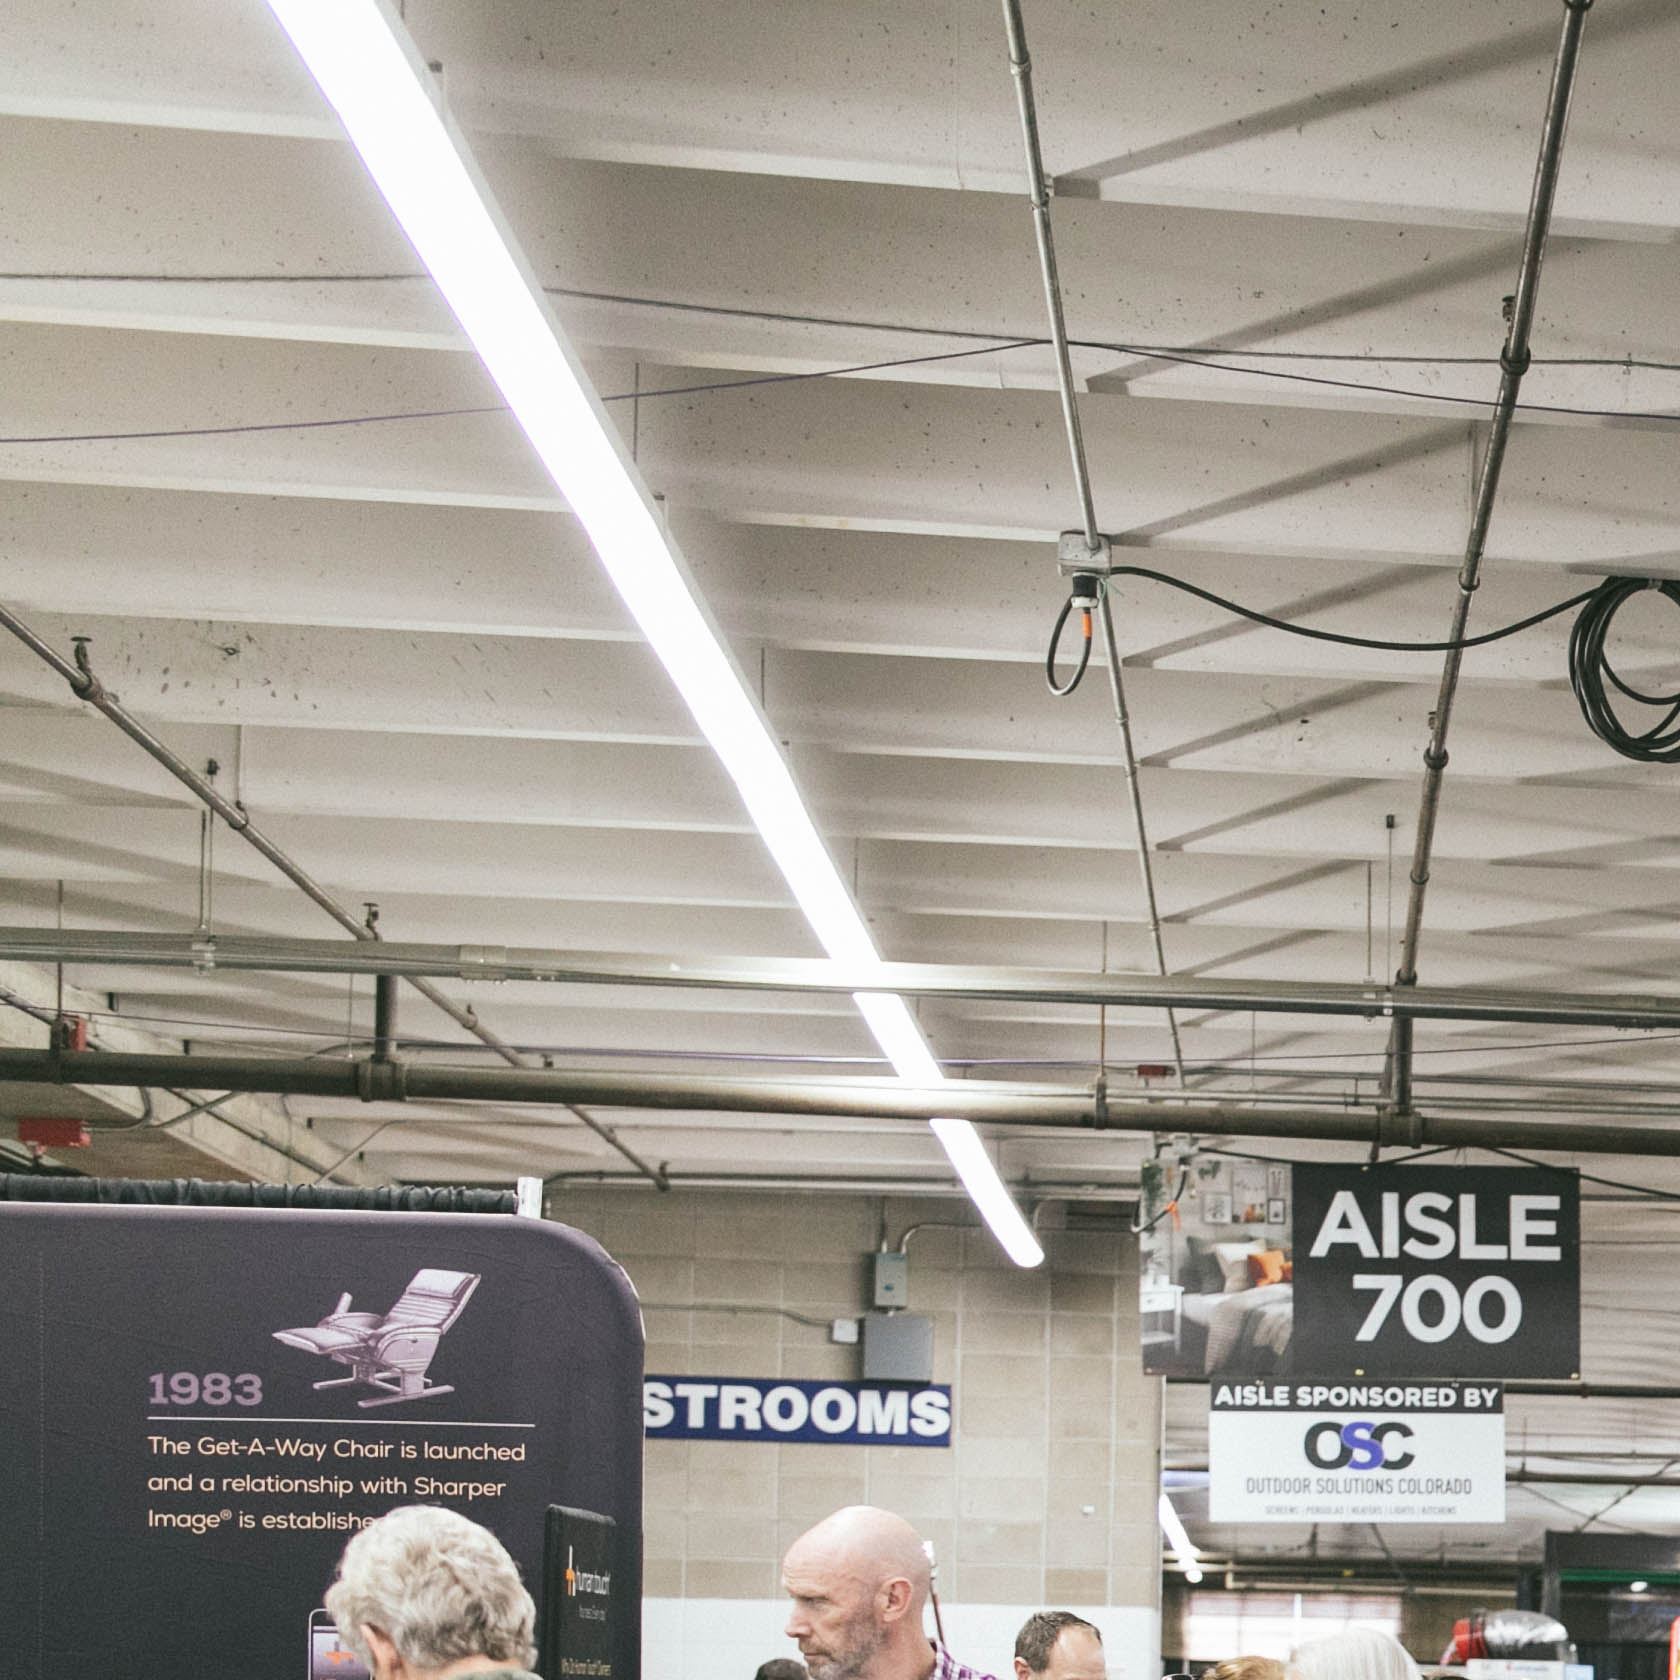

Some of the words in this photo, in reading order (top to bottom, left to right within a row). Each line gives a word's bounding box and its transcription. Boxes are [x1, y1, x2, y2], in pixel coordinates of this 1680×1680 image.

[1309, 1190, 1561, 1261] AISLE
[1352, 1274, 1522, 1344] 700
[148, 1372, 263, 1406] 1983
[1214, 1385, 1290, 1407] AISLE
[1296, 1386, 1457, 1408] SPONSORED
[1464, 1388, 1498, 1408] BY
[643, 1381, 951, 1437] STROOMS
[148, 1436, 191, 1456] The
[197, 1437, 327, 1462] Get-A-Way
[333, 1439, 394, 1459] Chair
[400, 1441, 418, 1459] is
[423, 1441, 526, 1461] launched
[1304, 1421, 1416, 1470] OSC
[148, 1474, 193, 1492] and
[200, 1478, 215, 1493] a
[222, 1475, 353, 1498] relationship
[360, 1476, 407, 1495] with
[414, 1477, 506, 1501] Sharper
[1246, 1477, 1311, 1495] OUTDOOR
[1316, 1478, 1394, 1495] SOLUTIONS
[1398, 1478, 1472, 1496] COLORADO
[239, 1511, 256, 1529] is
[262, 1511, 376, 1530] establishe
